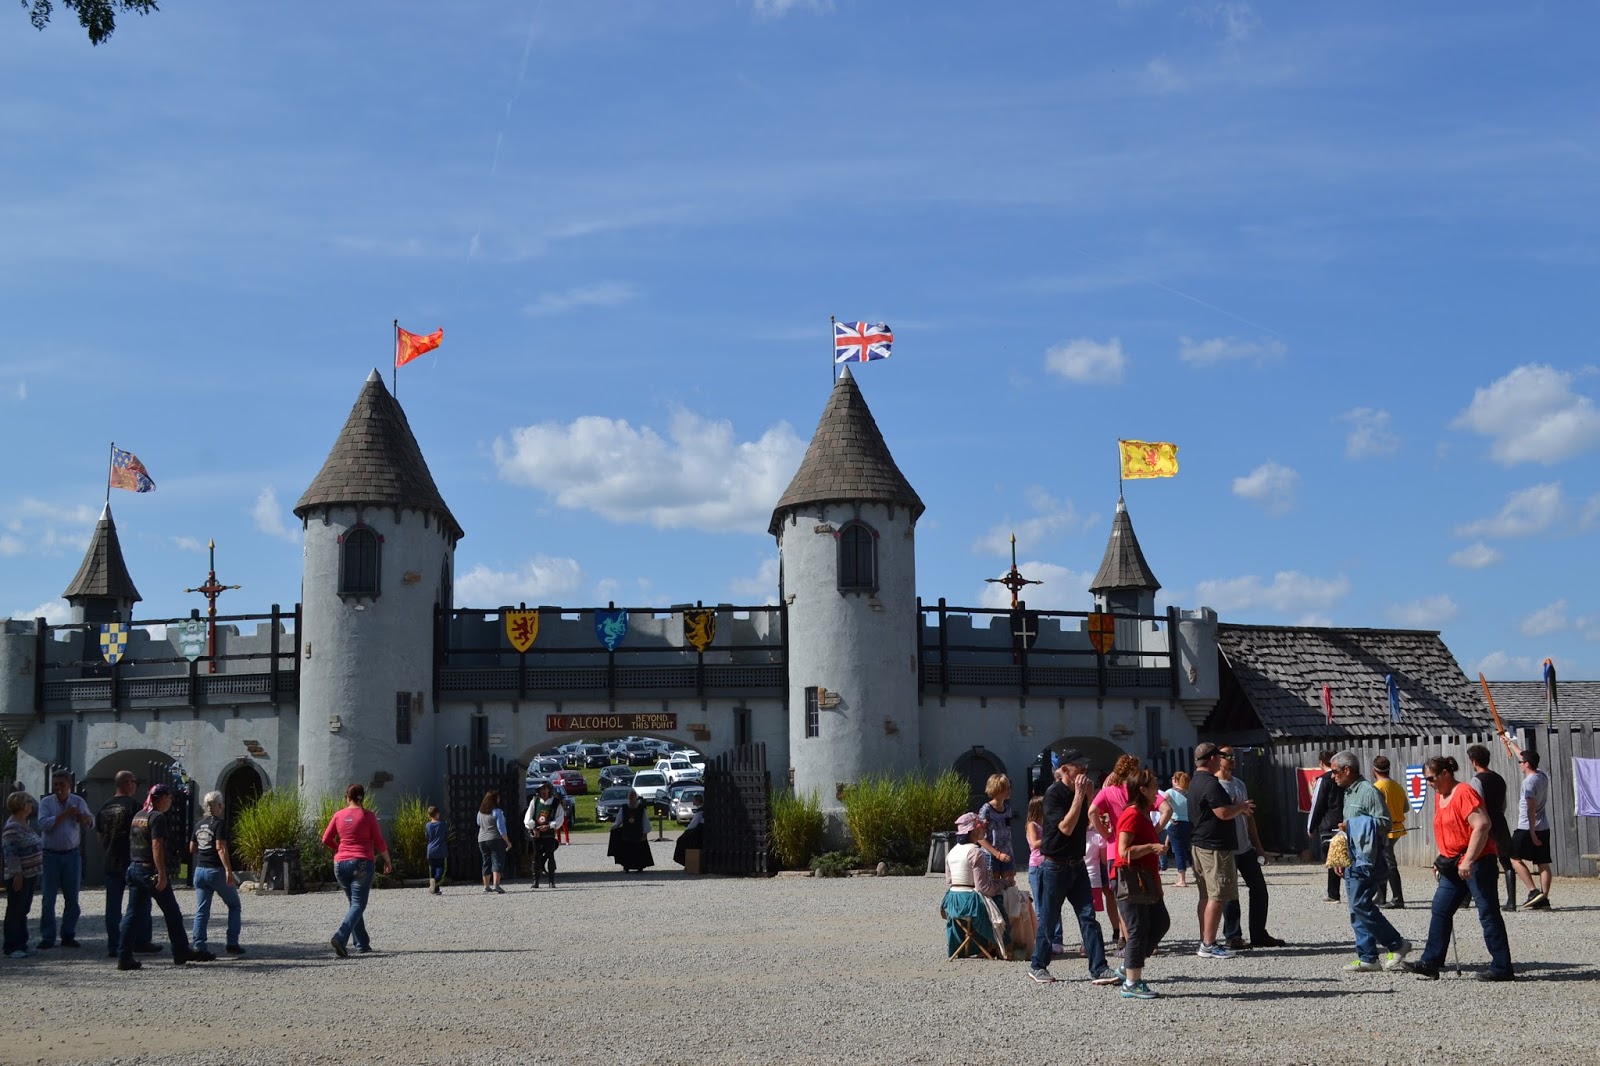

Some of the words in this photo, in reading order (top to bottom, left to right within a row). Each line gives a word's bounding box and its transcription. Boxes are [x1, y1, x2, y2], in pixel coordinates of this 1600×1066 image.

[635, 714, 668, 722] BEYOND
[569, 716, 623, 729] ALCOHOL
[631, 721, 649, 729] THIS
[651, 721, 674, 729] POINT
